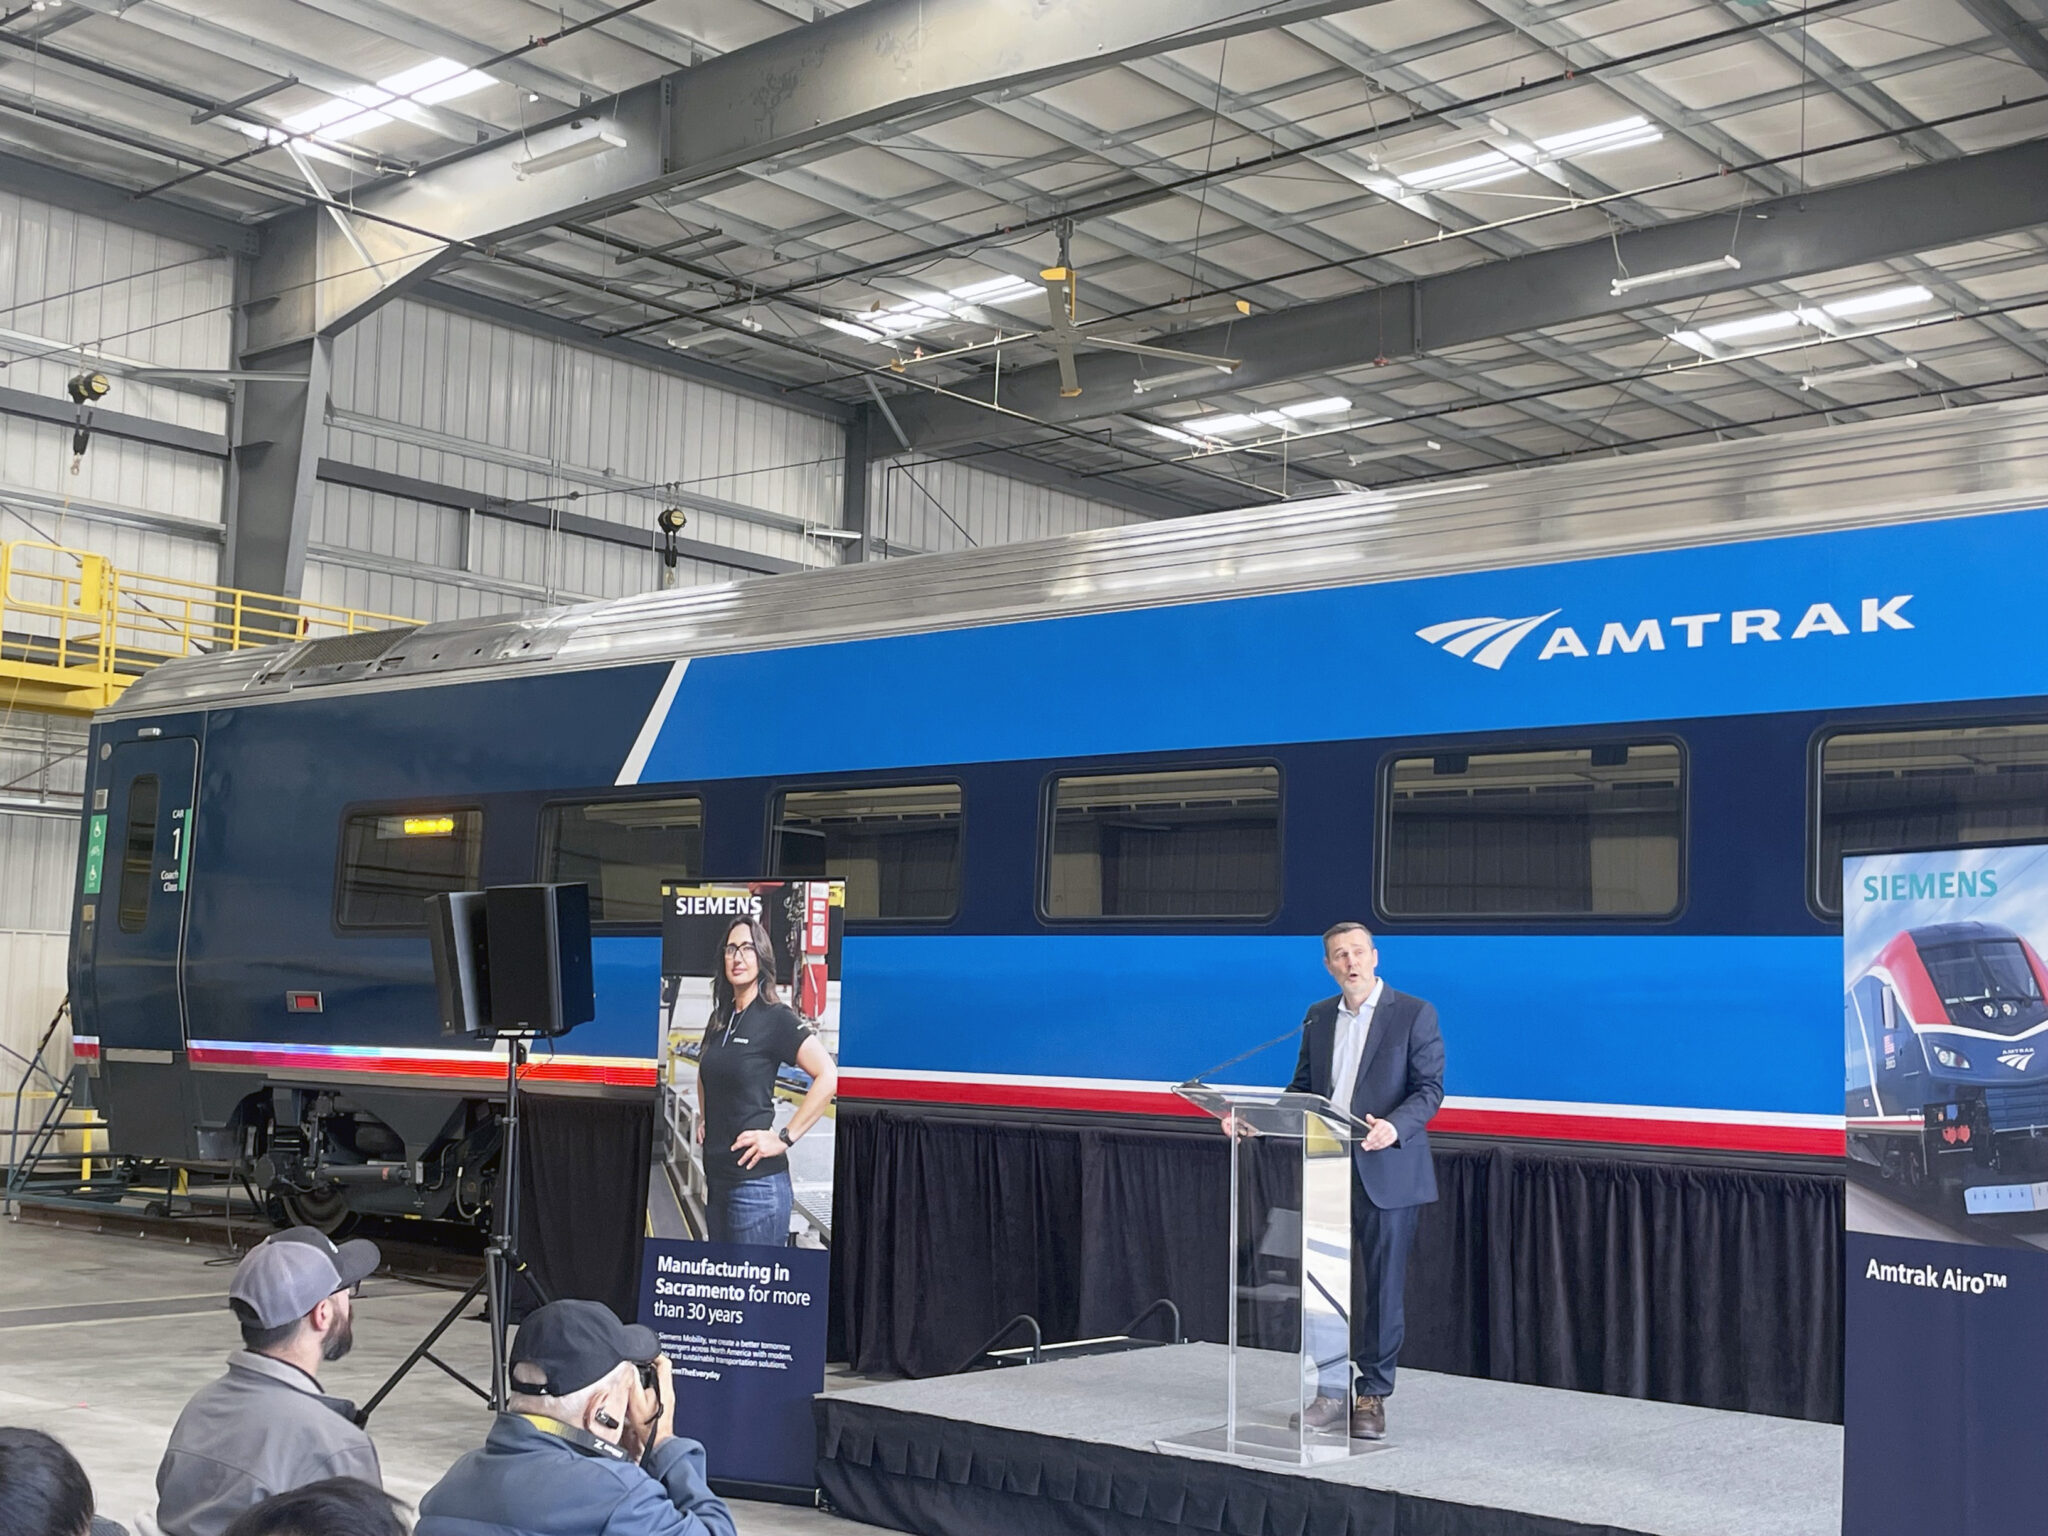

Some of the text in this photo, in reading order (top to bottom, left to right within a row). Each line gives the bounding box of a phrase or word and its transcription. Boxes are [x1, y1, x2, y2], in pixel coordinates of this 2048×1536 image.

[1538, 594, 1915, 660] AMTRAK
[172, 809, 184, 818] CAR
[173, 827, 181, 860] 1
[161, 870, 179, 880] Coach
[1864, 869, 1998, 902] SIEMENS
[676, 896, 762, 915] SIEMENS
[657, 1255, 790, 1284] Manufacturing in
[1866, 1258, 1939, 1288] Amtrak
[655, 1277, 811, 1306] Sacramento for more
[653, 1300, 743, 1325] than 30 years
[710, 1345, 727, 1355] North
[726, 1347, 752, 1357] America
[752, 1350, 767, 1358] with
[740, 1340, 760, 1349] better
[671, 1352, 682, 1360] and
[682, 1353, 716, 1363] sustainable
